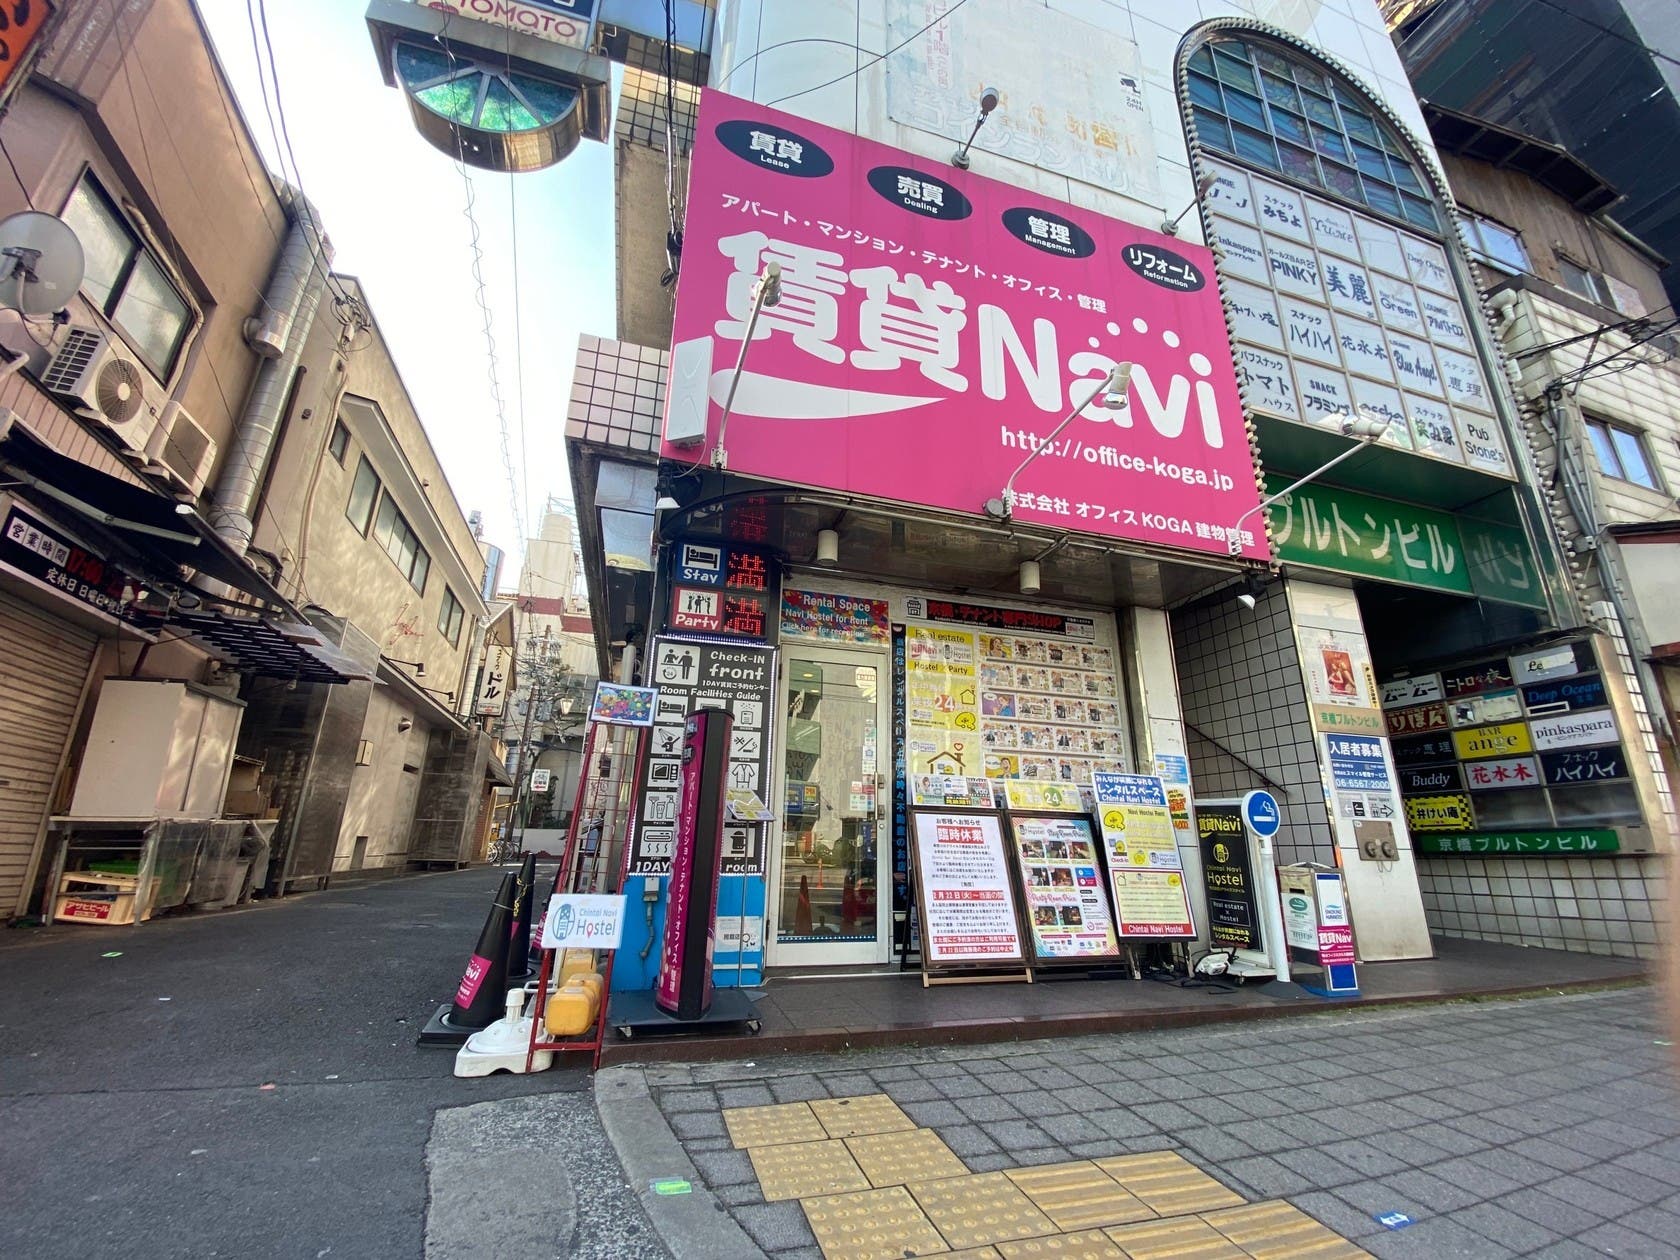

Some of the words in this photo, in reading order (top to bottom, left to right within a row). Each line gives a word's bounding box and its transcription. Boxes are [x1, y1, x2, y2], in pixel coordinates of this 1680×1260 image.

[748, 130, 803, 164] 賃貸
[760, 156, 790, 170] Lease
[897, 175, 945, 207] 売買
[904, 197, 938, 213] Dealing
[1264, 195, 1294, 210] スナック
[1264, 205, 1302, 229] みちよ
[1027, 215, 1071, 246] 管理
[1025, 234, 1077, 255] Management
[721, 193, 1107, 315] アパート・マンション・テナント・オフィス・管理
[1129, 248, 1198, 284] リフォーム
[1271, 258, 1318, 286] PINKY
[1142, 267, 1189, 288] Reformation
[1326, 265, 1373, 306] 美麗
[1291, 310, 1322, 325] スナック
[1381, 298, 1418, 319] Green
[1291, 324, 1333, 354] ハイハイ
[1341, 336, 1388, 361] 花水木
[1240, 350, 1283, 371] パブスナック
[1393, 350, 1414, 375] Blue
[1415, 357, 1438, 386] Angel
[1443, 361, 1475, 375] スナック
[1243, 366, 1290, 396] トマト
[1309, 379, 1338, 396] SNACK
[1448, 376, 1483, 398] 恵理
[1263, 397, 1295, 413] ハウス
[1415, 406, 1443, 420] スナック
[1467, 424, 1489, 441] Pub
[1000, 426, 1234, 492] http://office-koga.jp
[1465, 441, 1506, 463] Stone's
[1076, 502, 1138, 525] オフィス
[12, 523, 67, 564] 営業時間
[45, 567, 78, 592] 定休日
[683, 568, 718, 584] Stay
[726, 552, 766, 592] 満
[803, 594, 835, 609] Rental
[839, 598, 871, 612] Space
[675, 614, 719, 630] Party
[723, 596, 764, 636] 満
[785, 608, 804, 618] Navi
[806, 610, 833, 622] Hostel
[835, 613, 848, 623] for
[850, 616, 868, 626] Rent
[710, 651, 766, 665] Check-IN
[709, 664, 764, 681] front
[914, 662, 938, 671] Hostel
[949, 665, 968, 675] Party
[484, 672, 503, 699] ドル
[660, 685, 688, 696] Room
[690, 688, 733, 699] Facilities
[736, 690, 761, 701] Guide
[1528, 691, 1557, 703] Deep
[1561, 682, 1601, 695] Ocean
[935, 695, 955, 712] 24
[1391, 710, 1446, 732] りぼん
[1478, 727, 1502, 737] BAR
[1536, 721, 1613, 740] pinkaspara
[1330, 742, 1383, 758] 入居者募集
[1469, 736, 1518, 753] ange
[1563, 751, 1599, 764] スナック
[1412, 773, 1450, 787] Buddy
[1472, 763, 1533, 784] 花水木
[1556, 761, 1616, 782] ハイハイ
[1045, 792, 1061, 804] 24
[1098, 784, 1161, 797] レンタルスペース
[1102, 794, 1125, 802] Chintai
[1141, 796, 1161, 804] Hostel
[936, 818, 981, 826] お客様へお知らせ
[938, 827, 984, 842] 臨時休業
[635, 860, 670, 873] 1DAY
[725, 862, 758, 873] room
[1207, 872, 1244, 886] Hostel
[67, 902, 111, 912] アサヒビール
[579, 907, 600, 917] Chintai
[603, 909, 618, 917] Navi
[575, 920, 616, 938] Hostel
[1128, 925, 1150, 933] Chintai
